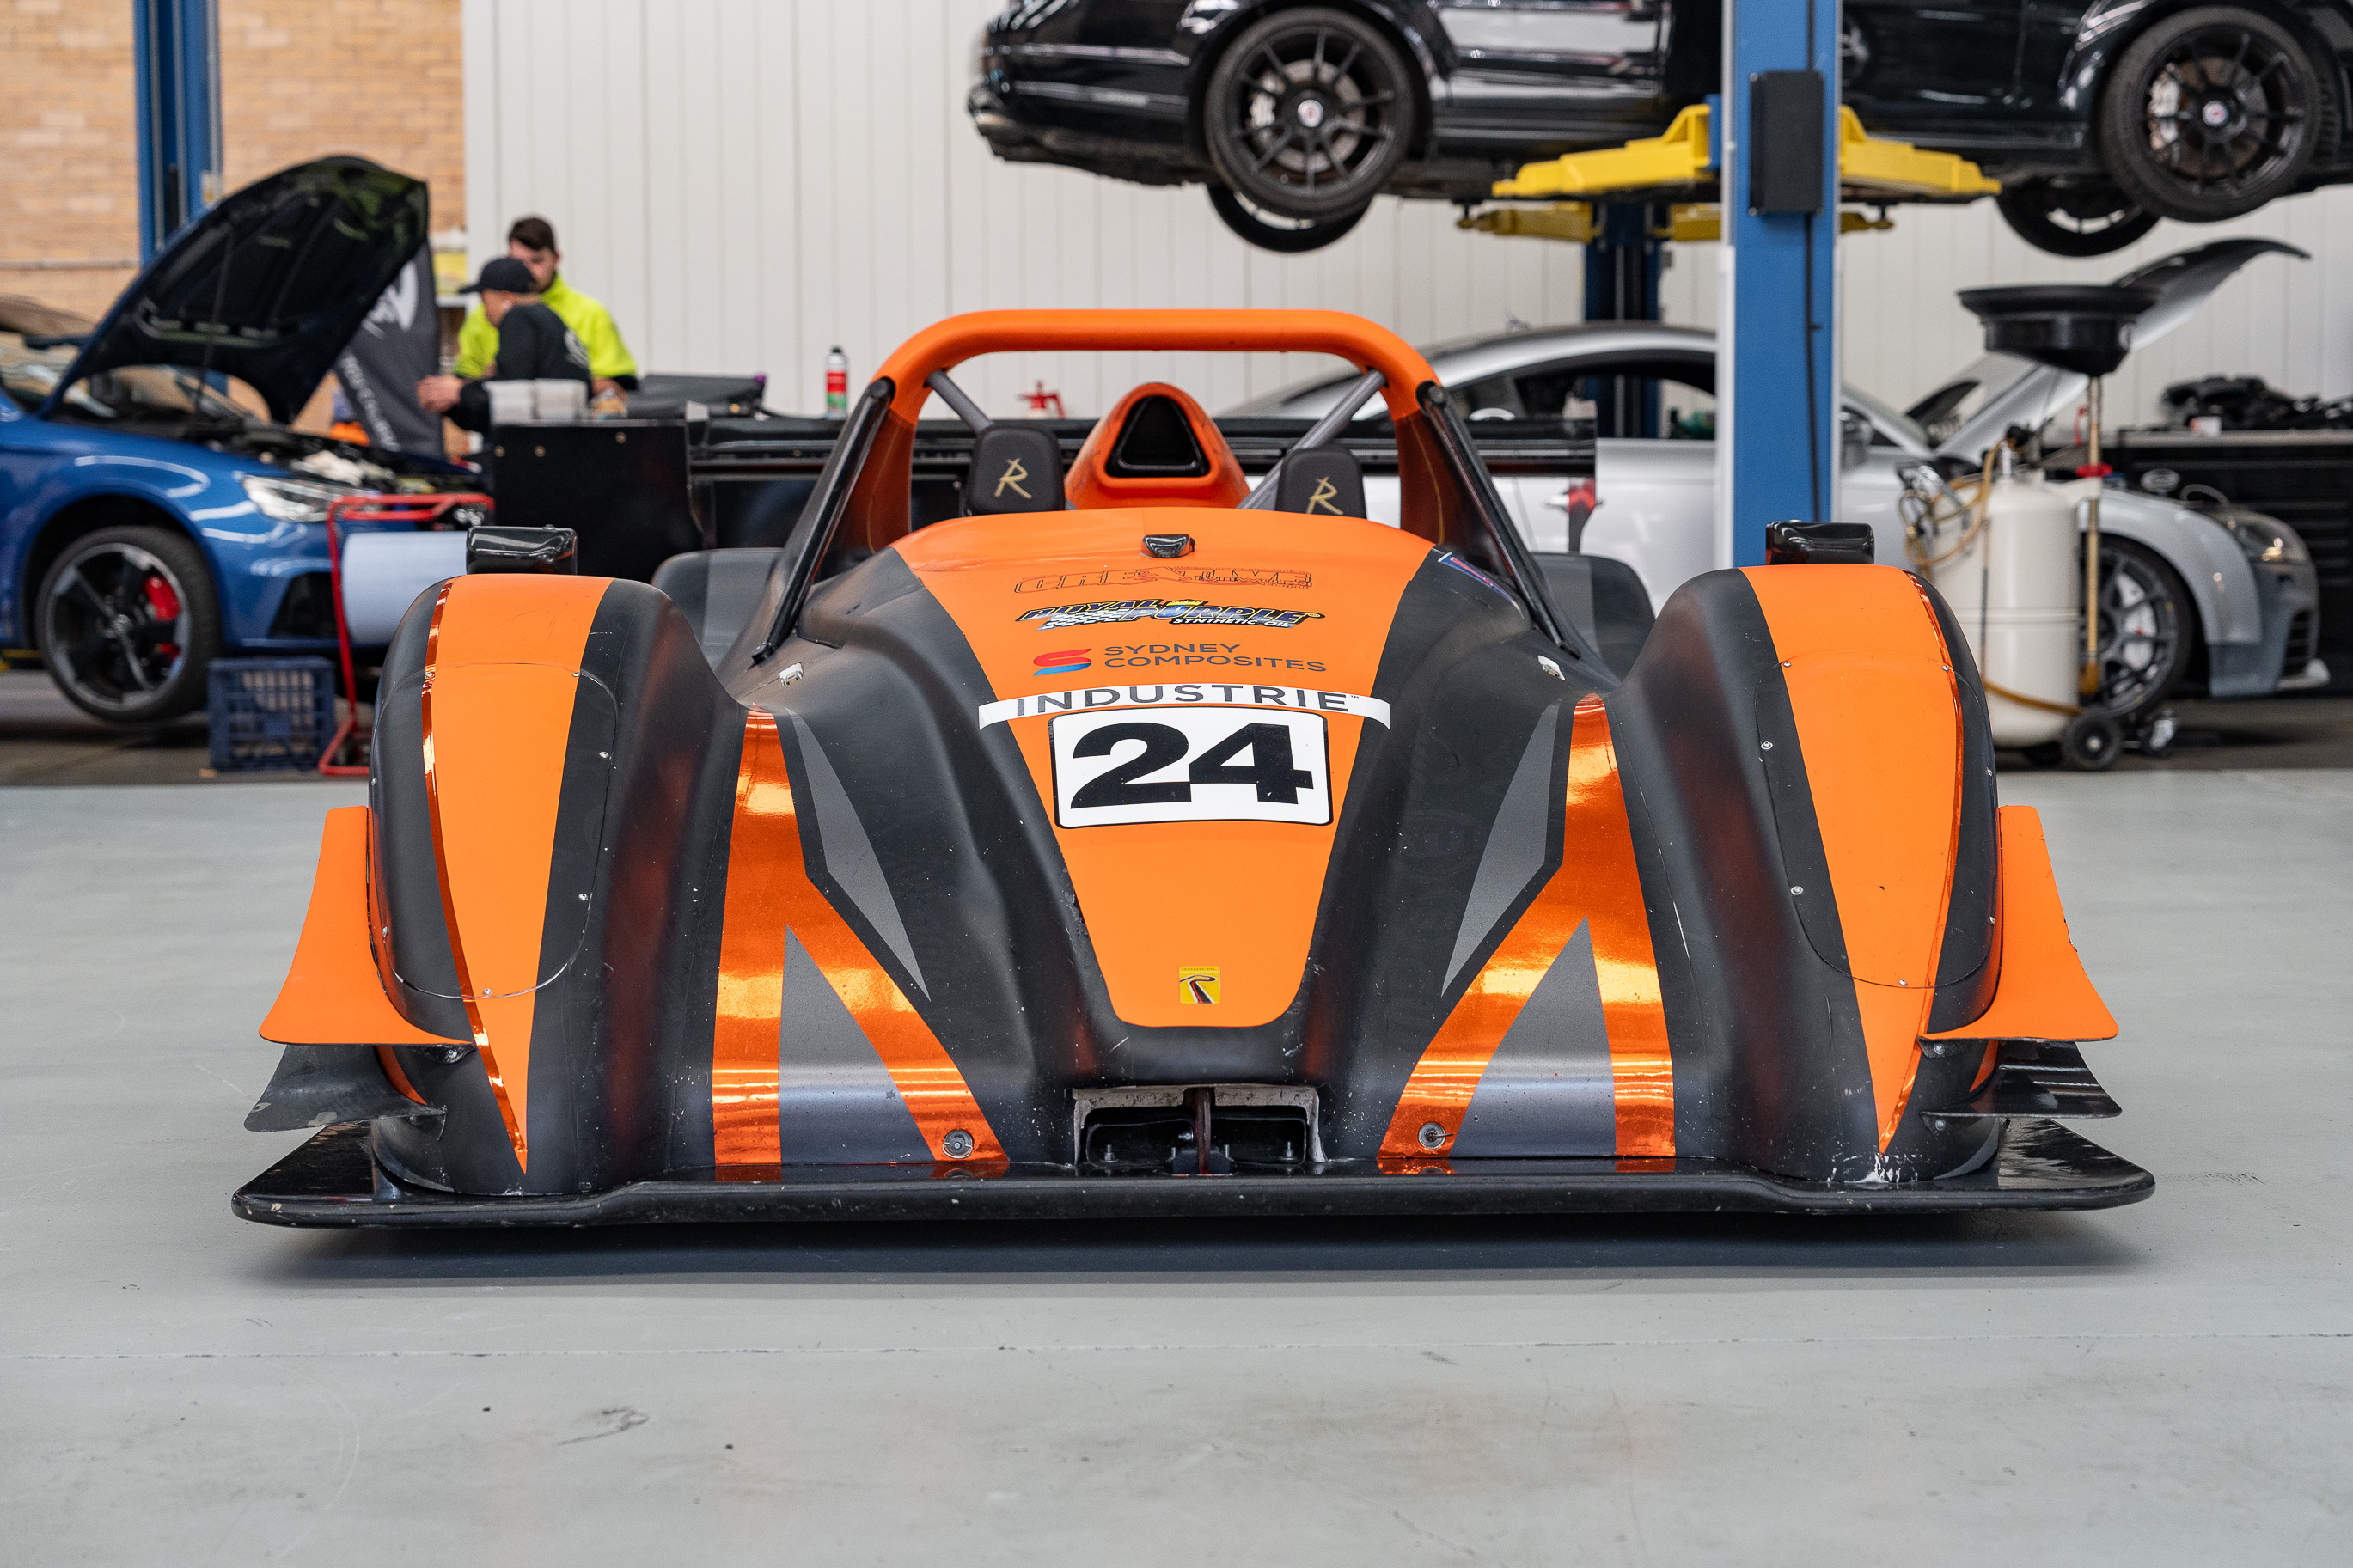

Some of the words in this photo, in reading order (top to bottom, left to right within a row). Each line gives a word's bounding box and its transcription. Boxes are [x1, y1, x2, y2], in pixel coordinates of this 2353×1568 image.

[994, 457, 1032, 499] R
[1018, 600, 1164, 621] ROYAL
[1118, 605, 1309, 624] PURPLE
[1104, 644, 1241, 656] SYDNEY
[1104, 656, 1327, 672] COMPOSITES
[1071, 723, 1314, 809] 24
